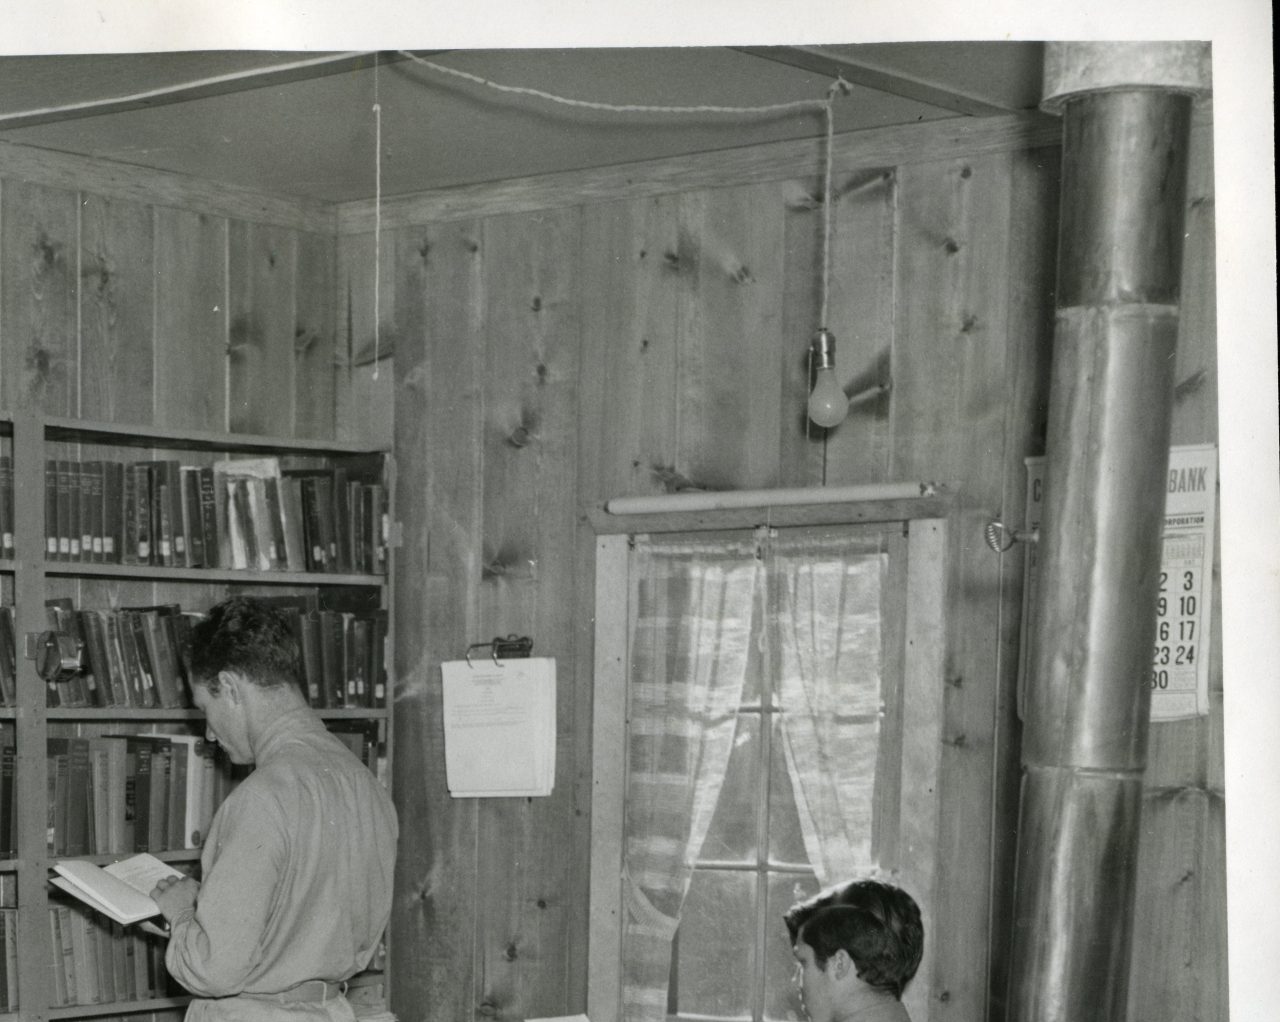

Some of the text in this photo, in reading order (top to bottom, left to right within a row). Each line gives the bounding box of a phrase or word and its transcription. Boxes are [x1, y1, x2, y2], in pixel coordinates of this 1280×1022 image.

[1168, 467, 1207, 493] BANK
[1183, 571, 1194, 591] 3
[1180, 596, 1197, 616] 10
[1179, 621, 1195, 641] 17
[1175, 645, 1195, 665] 24
